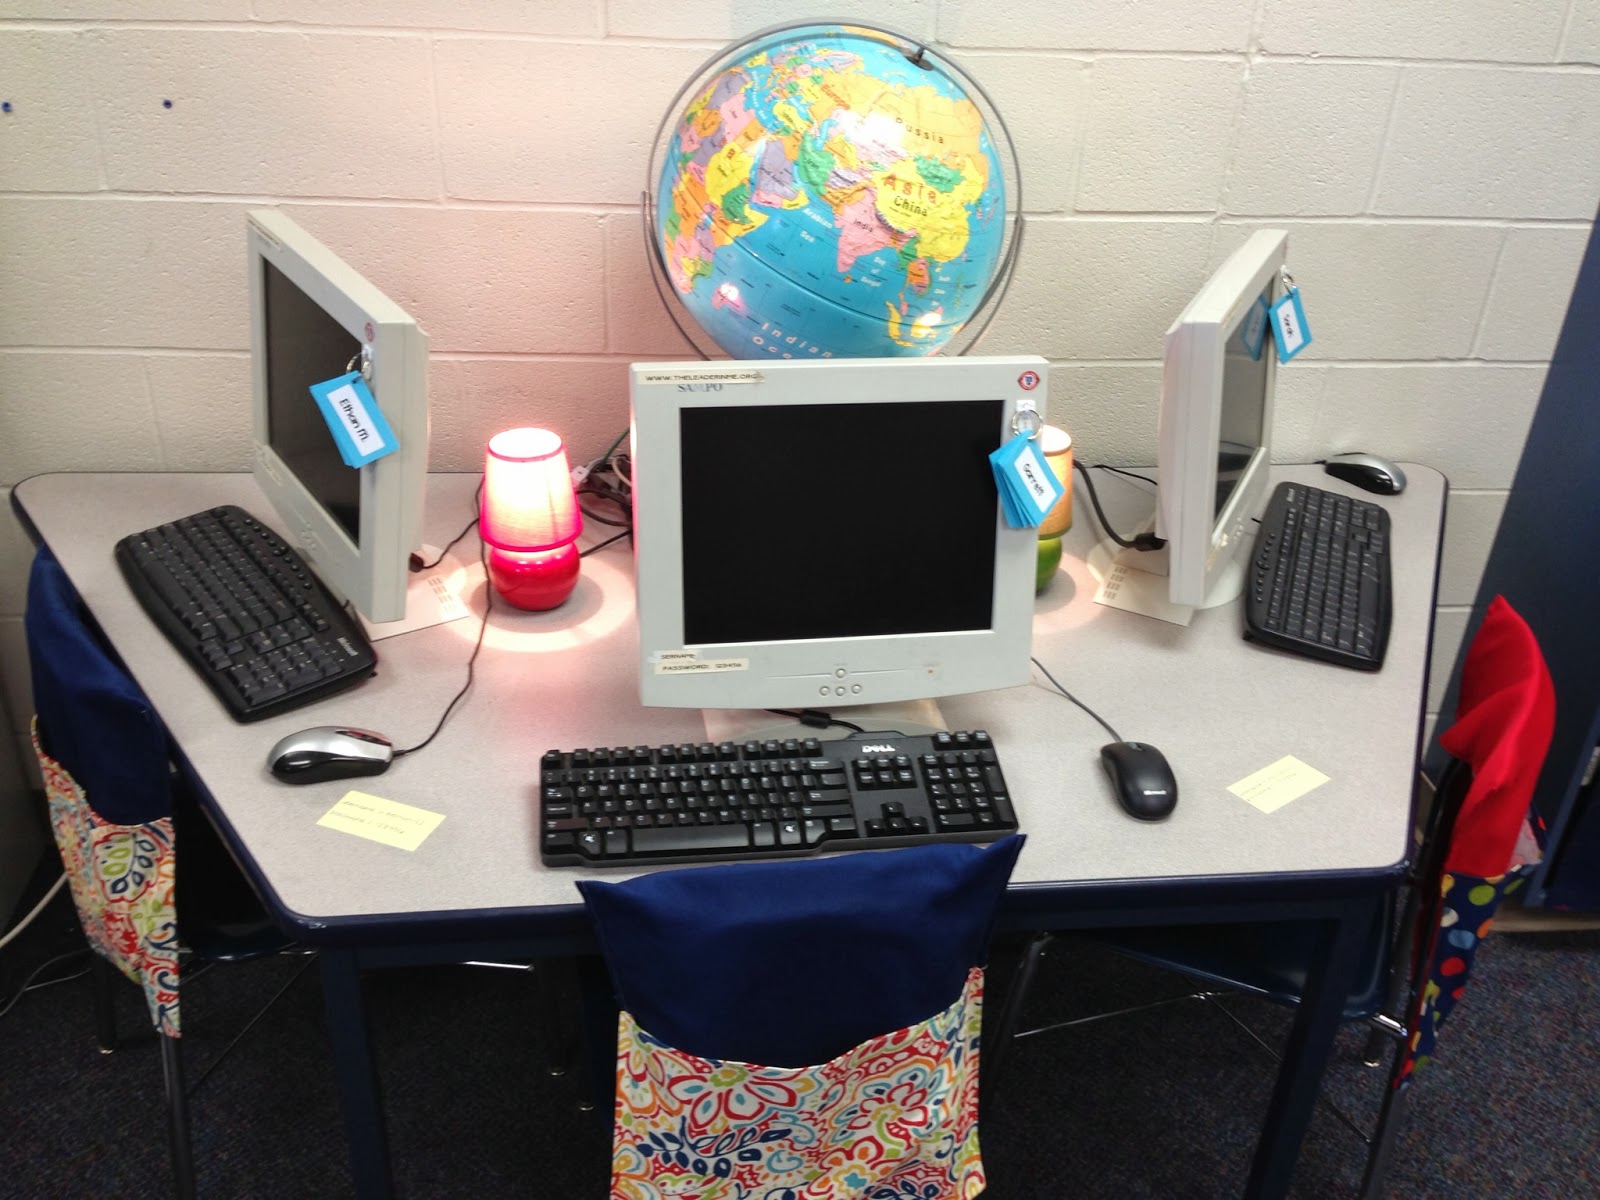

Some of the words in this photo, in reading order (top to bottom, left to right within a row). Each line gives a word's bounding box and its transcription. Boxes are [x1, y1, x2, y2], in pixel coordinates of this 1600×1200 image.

[883, 173, 937, 206] Asia
[893, 195, 928, 217] China
[802, 208, 833, 229] Arabian
[853, 218, 874, 233] India
[800, 231, 815, 243] Sea
[752, 336, 792, 358] Oce
[761, 322, 833, 358] Indian
[677, 383, 723, 392] SAPO
[339, 398, 360, 429] Ethan
[861, 744, 896, 753] DELL
